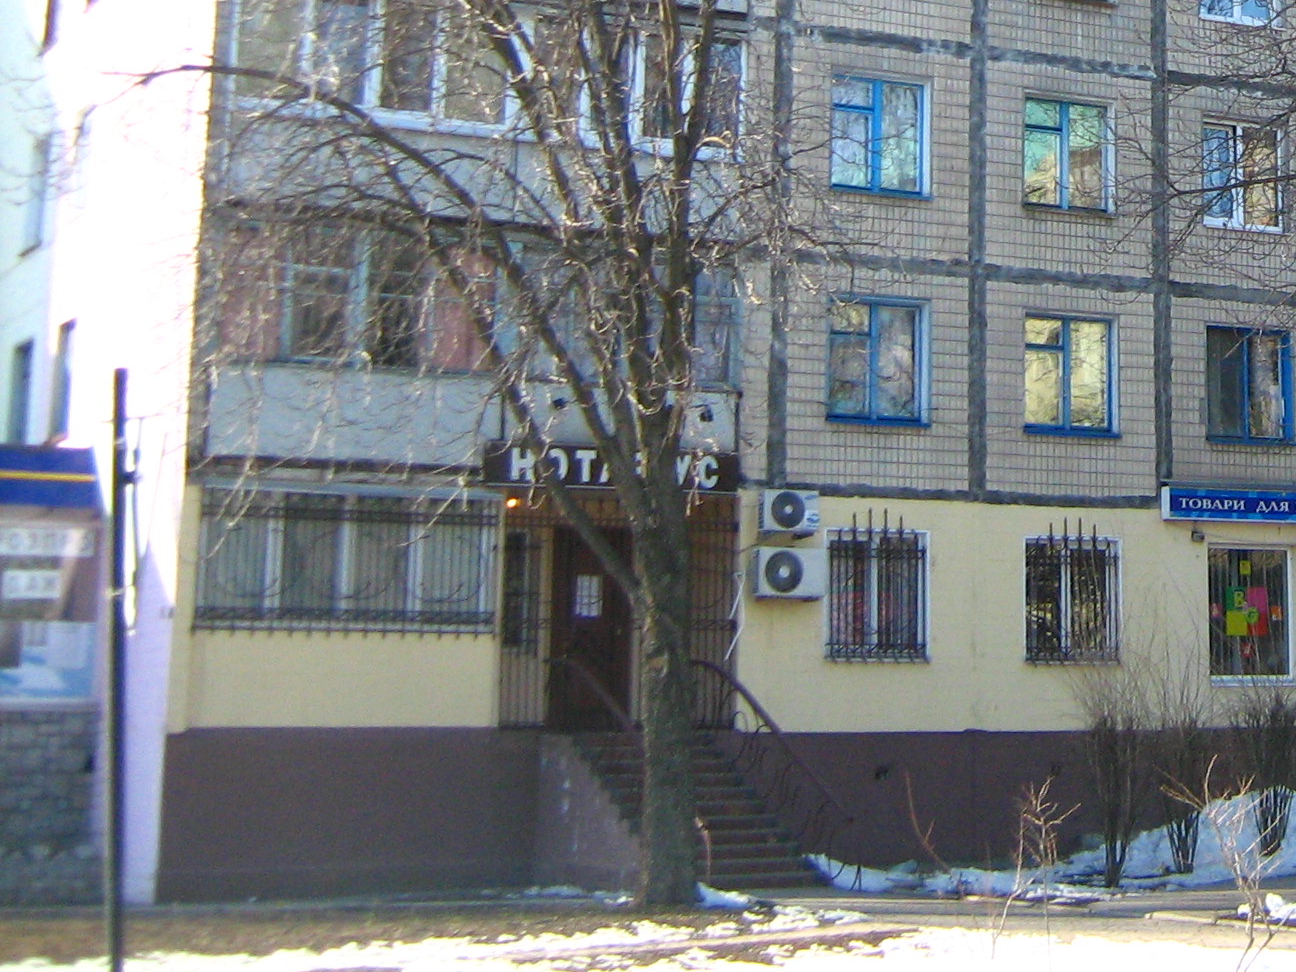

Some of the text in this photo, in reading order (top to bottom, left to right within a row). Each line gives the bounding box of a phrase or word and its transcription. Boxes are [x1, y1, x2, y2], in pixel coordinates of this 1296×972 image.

[511, 447, 720, 489] НОТУС
[1179, 497, 1246, 511] ТОВАРИ
[1255, 500, 1290, 514] ДЛЯ
